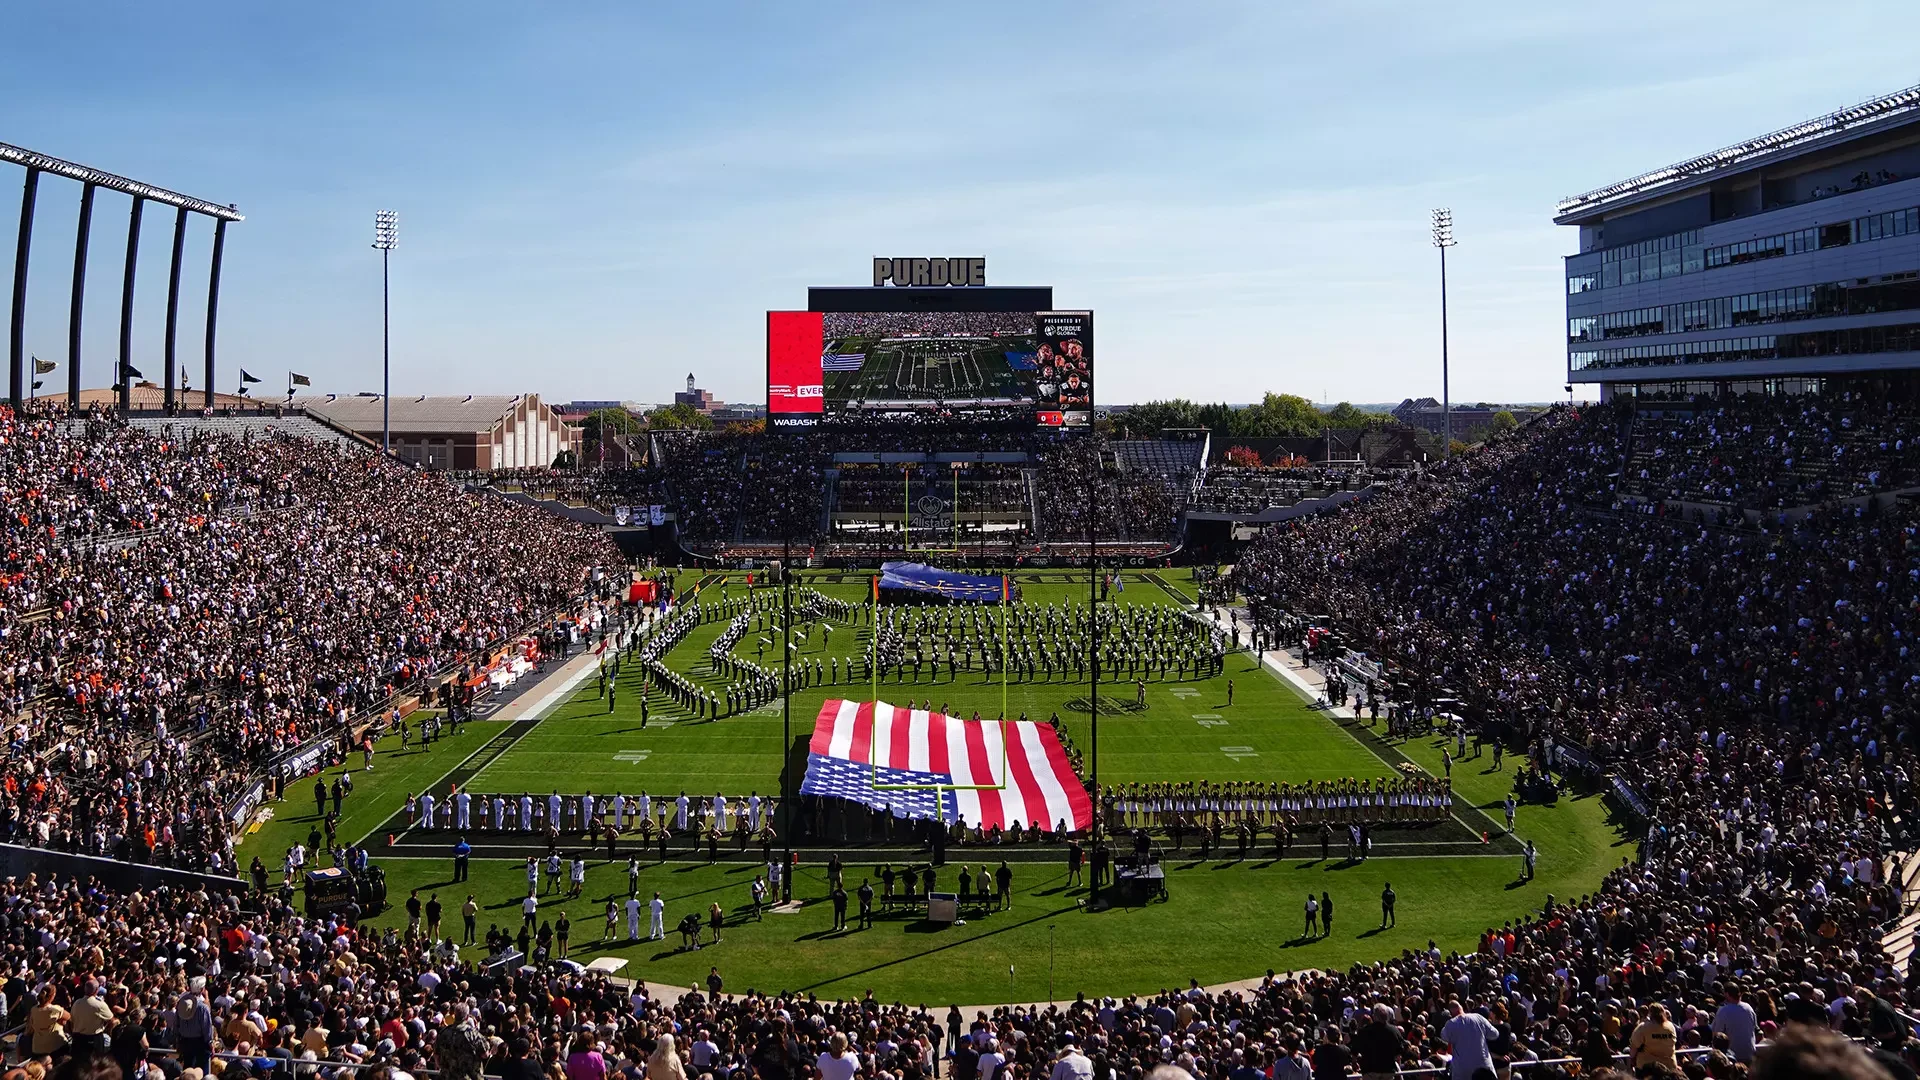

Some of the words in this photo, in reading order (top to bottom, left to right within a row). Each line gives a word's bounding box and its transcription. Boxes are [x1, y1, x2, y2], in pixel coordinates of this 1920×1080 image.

[873, 258, 985, 286] PURDUE
[800, 387, 823, 396] EVER
[910, 517, 950, 528] Allstate
[318, 893, 348, 903] PURDUE
